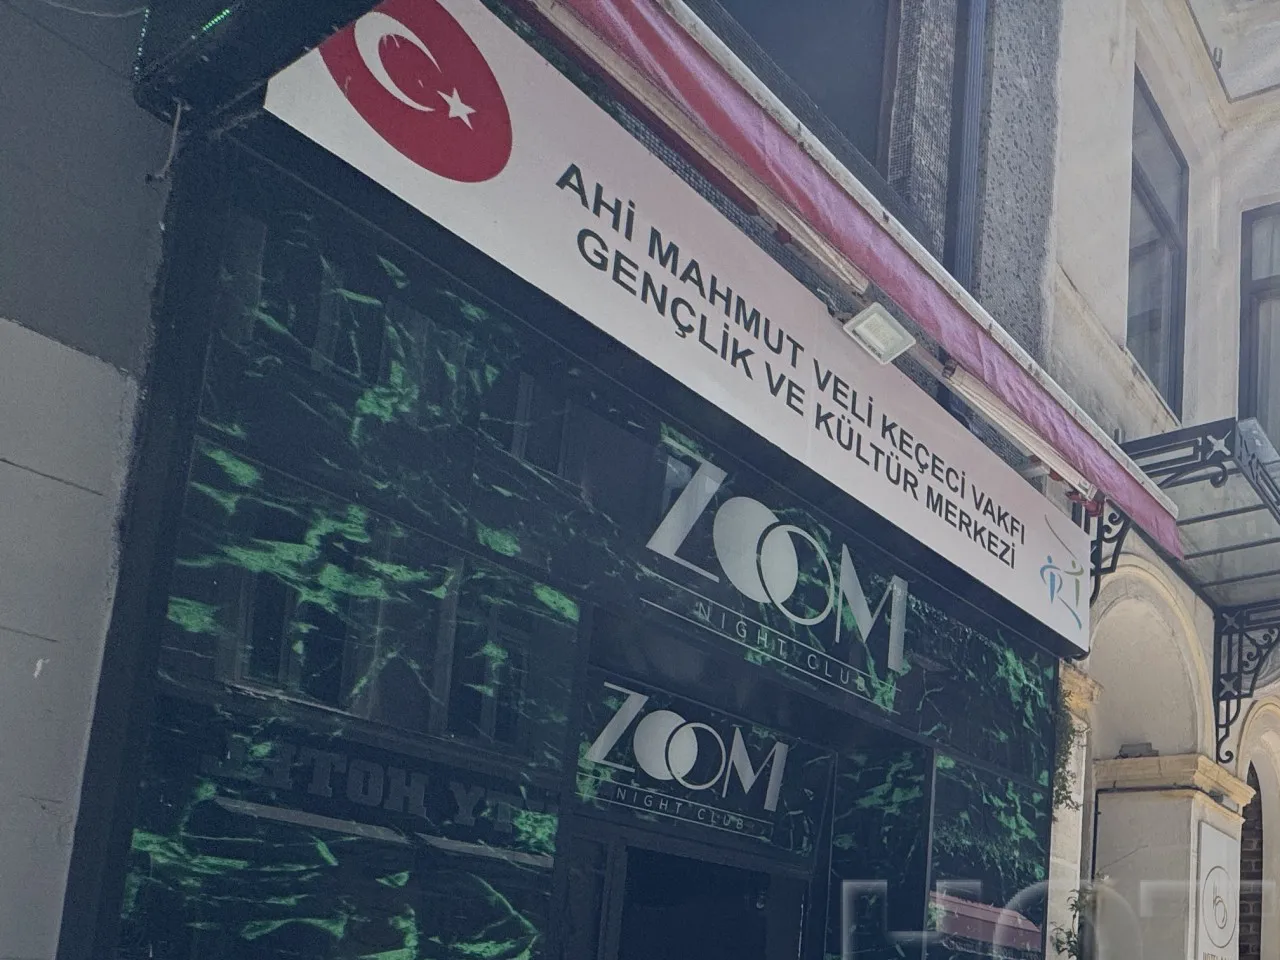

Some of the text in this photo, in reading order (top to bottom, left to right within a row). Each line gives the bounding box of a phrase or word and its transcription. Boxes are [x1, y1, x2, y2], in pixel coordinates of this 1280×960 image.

[555, 163, 1025, 545] AHİ MAHMUT VELİ KEÇECİ VAKFI
[576, 228, 1016, 569] GENÇLİK VE KÜLTÜR MERKEZİ
[645, 434, 908, 675] ZOOM
[697, 601, 866, 693] NIGHT CLUB
[584, 681, 789, 812] ZOOM
[616, 786, 745, 831] NIGHT CLUB
